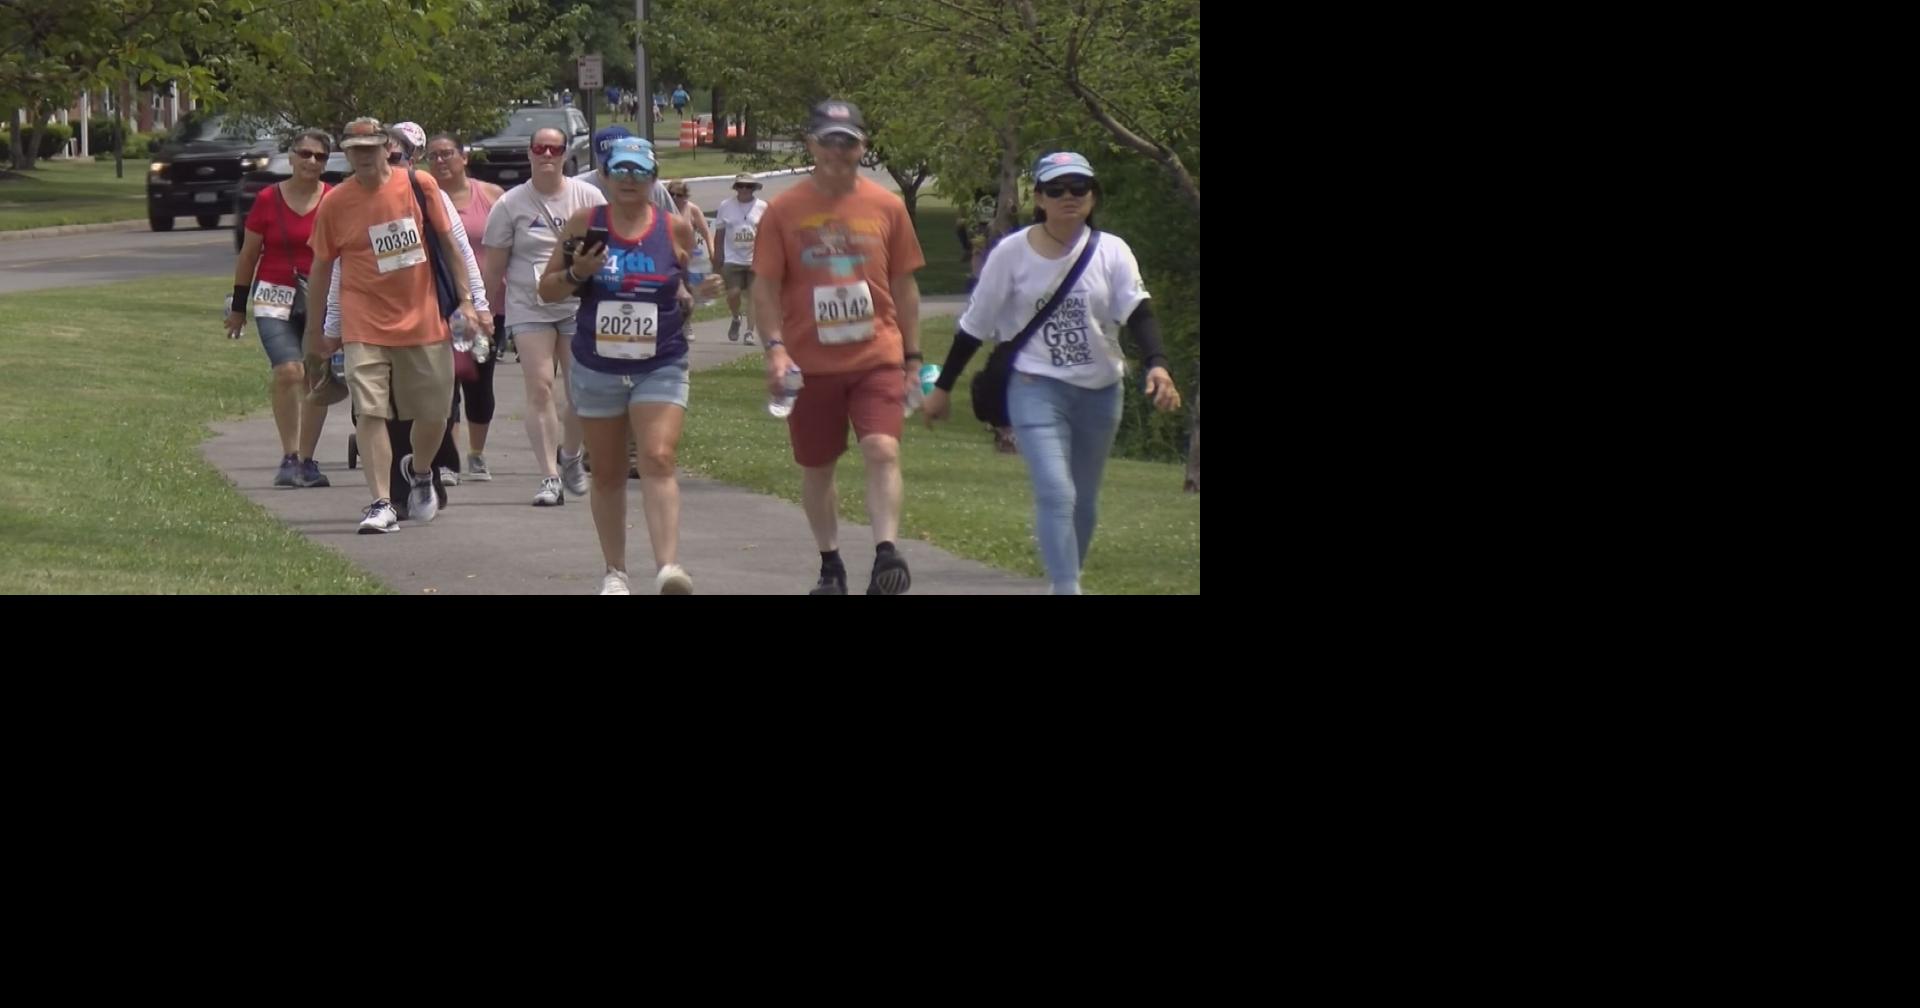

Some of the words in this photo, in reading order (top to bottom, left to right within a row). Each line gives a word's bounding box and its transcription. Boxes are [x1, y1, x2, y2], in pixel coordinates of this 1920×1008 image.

[375, 229, 417, 253] 20330
[256, 287, 293, 304] 20250
[1035, 297, 1087, 312] CRAL
[818, 296, 869, 321] 20142
[600, 315, 653, 336] 20212
[1043, 321, 1088, 347] GOT
[1049, 347, 1093, 367] BACK
